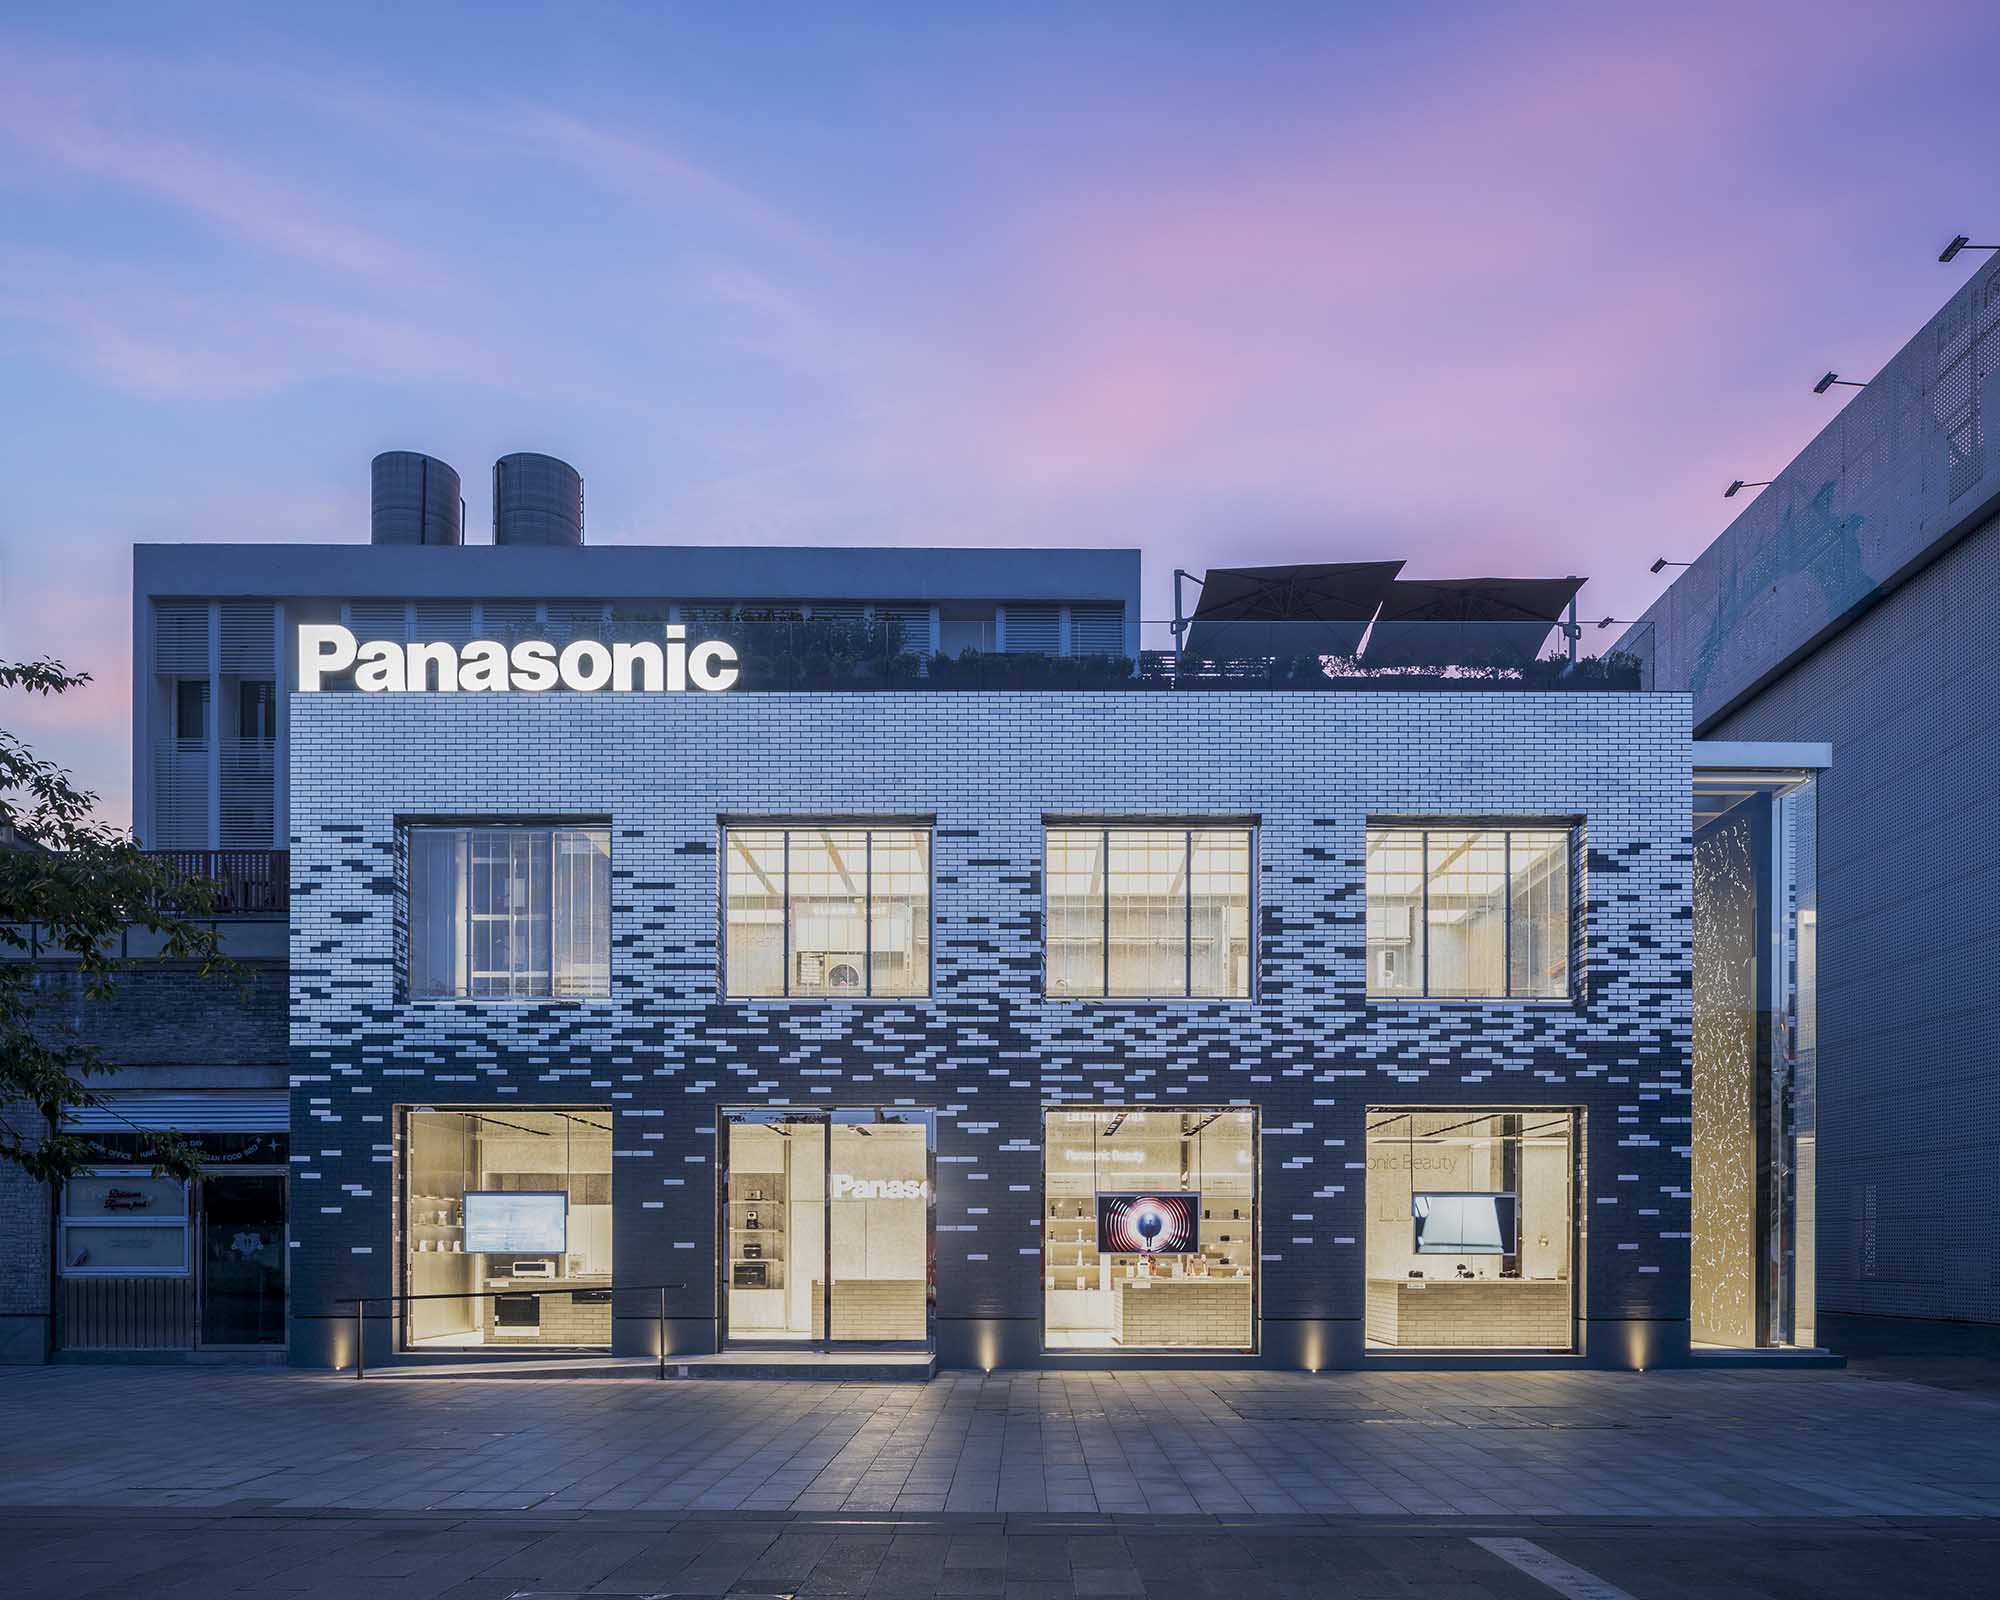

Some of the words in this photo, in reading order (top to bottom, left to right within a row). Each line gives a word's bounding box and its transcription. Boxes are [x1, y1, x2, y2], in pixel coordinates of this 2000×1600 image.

[298, 624, 739, 692] Panasonic
[223, 1152, 242, 1162] FOOD
[1402, 1154, 1458, 1175] Beauty
